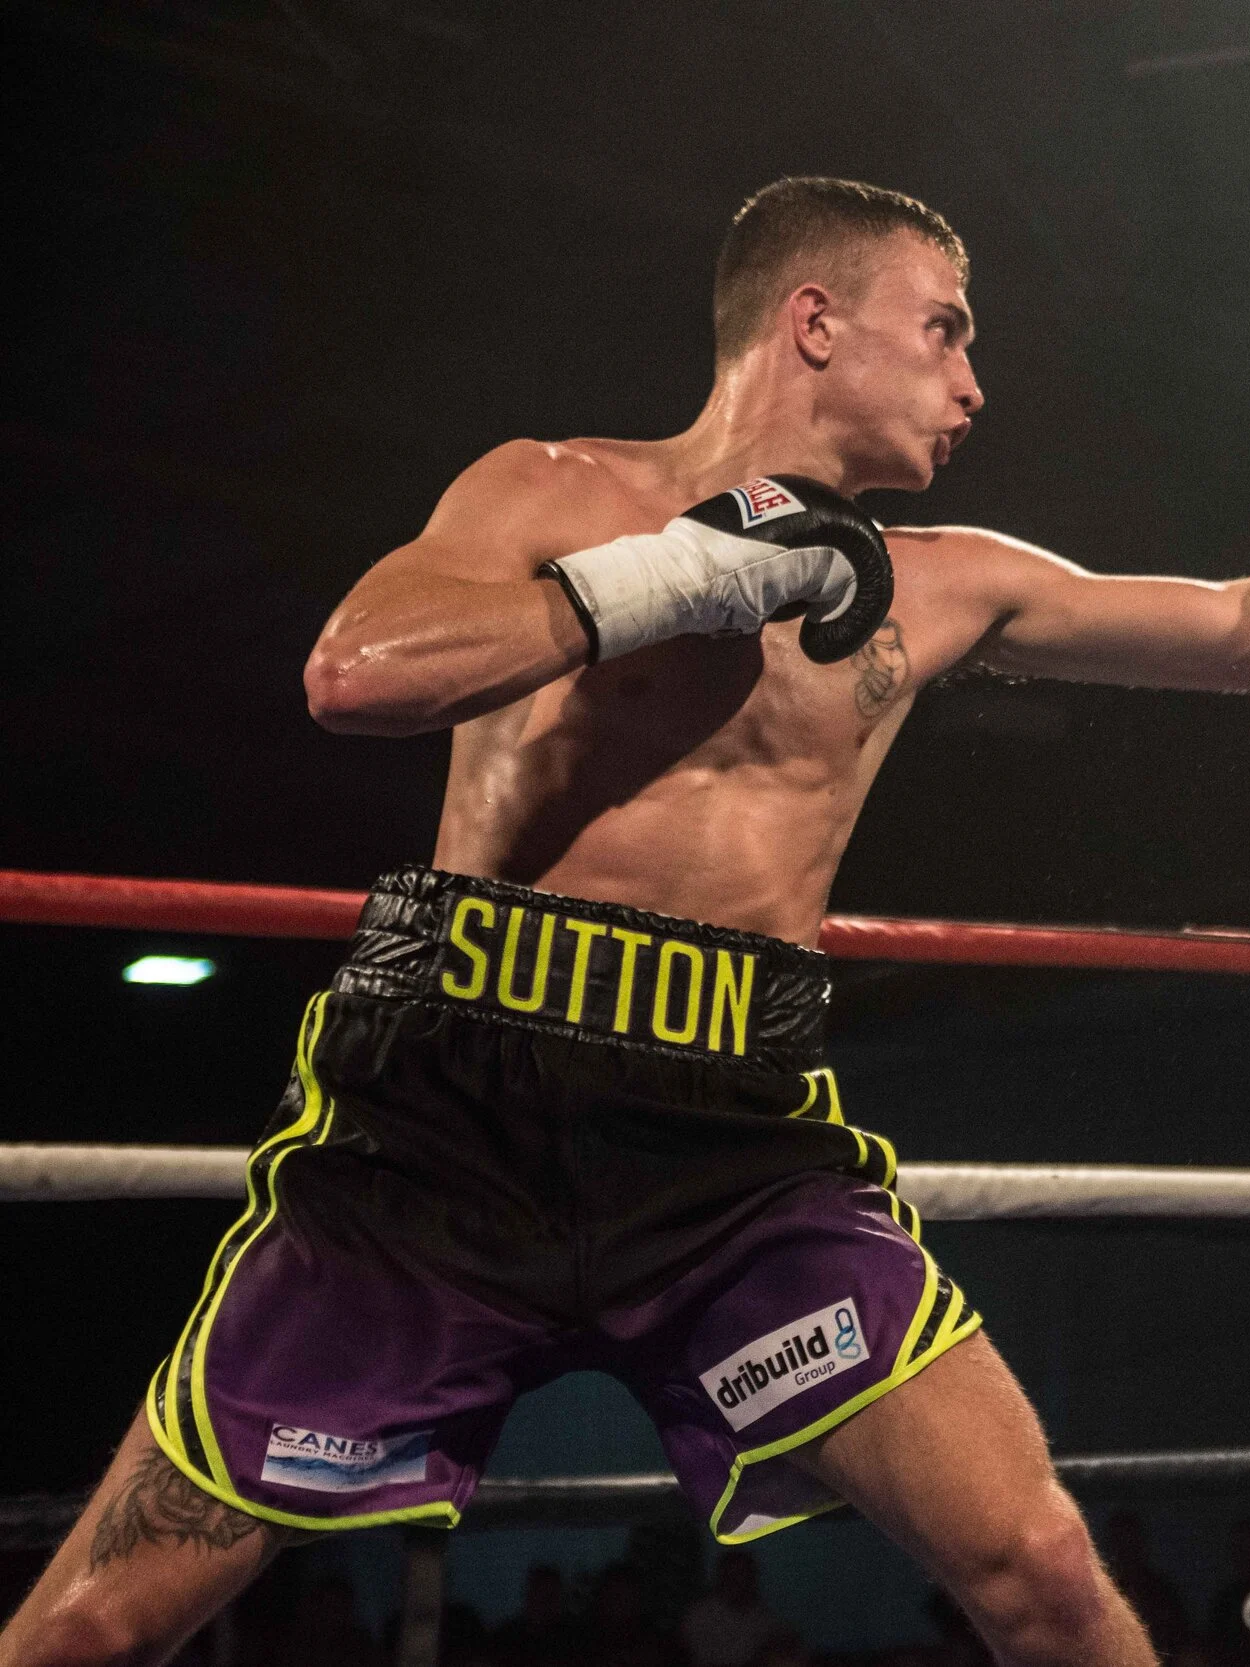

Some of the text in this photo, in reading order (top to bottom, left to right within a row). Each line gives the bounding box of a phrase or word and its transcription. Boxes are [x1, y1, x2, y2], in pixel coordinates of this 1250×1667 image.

[441, 897, 756, 1057] SUTTON
[716, 1325, 830, 1409] dribuild
[794, 1361, 836, 1386] Group
[270, 1440, 318, 1454] LAUNDRY
[272, 1426, 378, 1456] CANES
